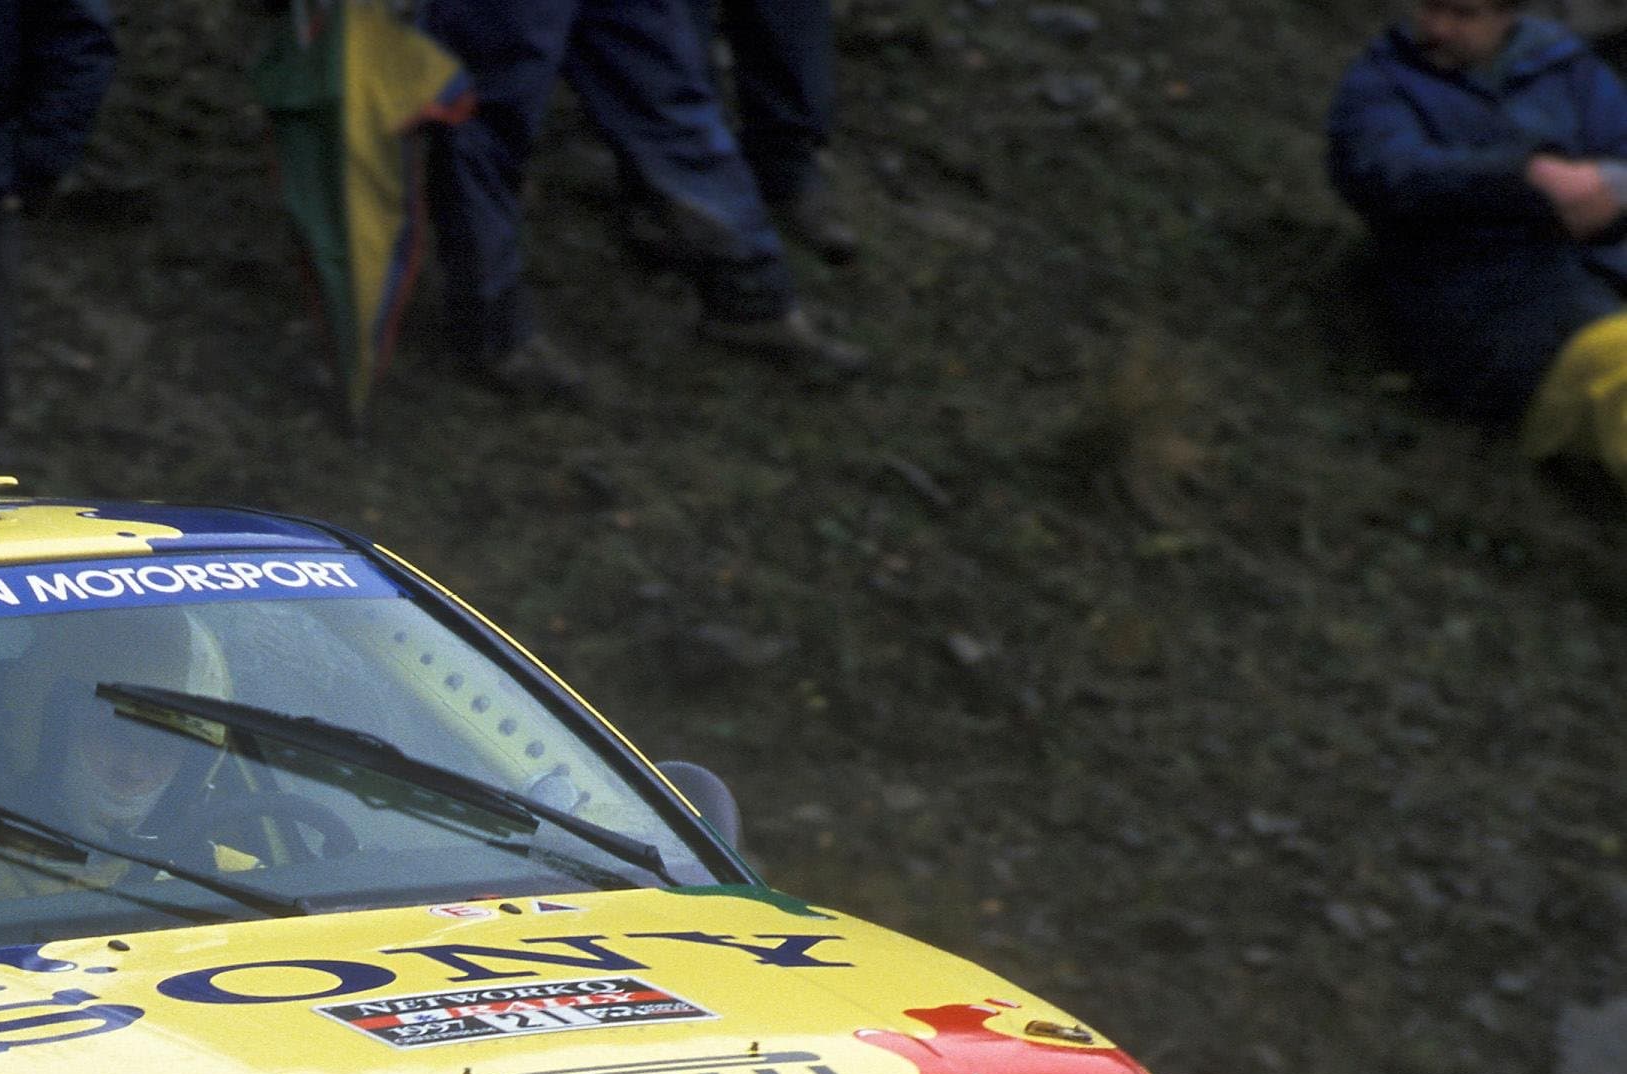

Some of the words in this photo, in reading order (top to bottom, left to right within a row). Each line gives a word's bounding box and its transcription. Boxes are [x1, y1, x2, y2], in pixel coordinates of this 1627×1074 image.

[25, 561, 358, 603] MOTORSPORT
[356, 981, 572, 1016] NETWORK
[577, 980, 625, 996] Q
[448, 990, 638, 1017] RALLY
[494, 1007, 572, 1028] 21
